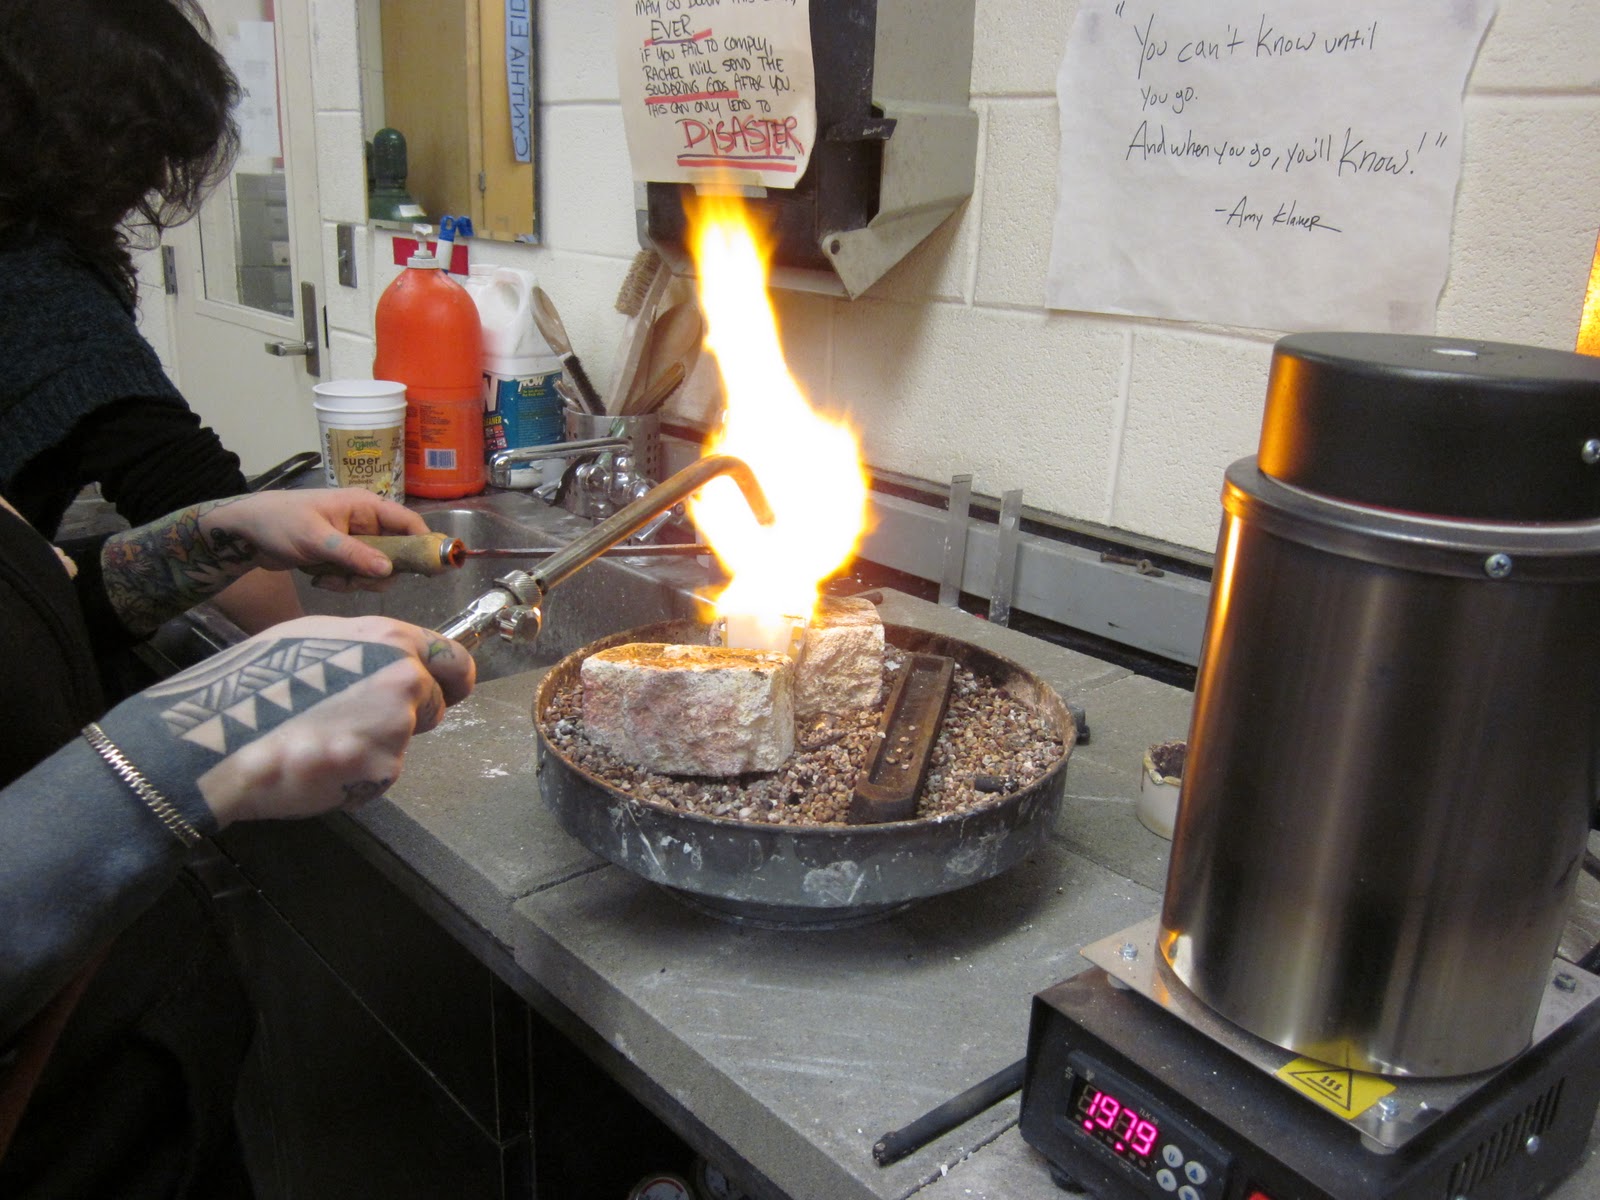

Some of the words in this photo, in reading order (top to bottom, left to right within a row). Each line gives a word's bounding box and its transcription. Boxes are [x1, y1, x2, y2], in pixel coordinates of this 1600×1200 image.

[1178, 25, 1244, 63] can't
[1325, 21, 1377, 54] until
[657, 47, 675, 67] YOU
[705, 39, 719, 53] TO
[758, 56, 784, 73] THE
[734, 73, 765, 91] AFTER
[670, 101, 689, 115] CAN
[694, 100, 720, 118] ONLY
[756, 99, 771, 113] TO
[1126, 120, 1167, 161] And
[1170, 130, 1210, 157] when
[1214, 141, 1246, 165] you
[1285, 134, 1331, 173] you'll
[343, 457, 380, 468] super
[347, 461, 392, 478] yogurt
[1087, 1091, 1159, 1156] 1979
